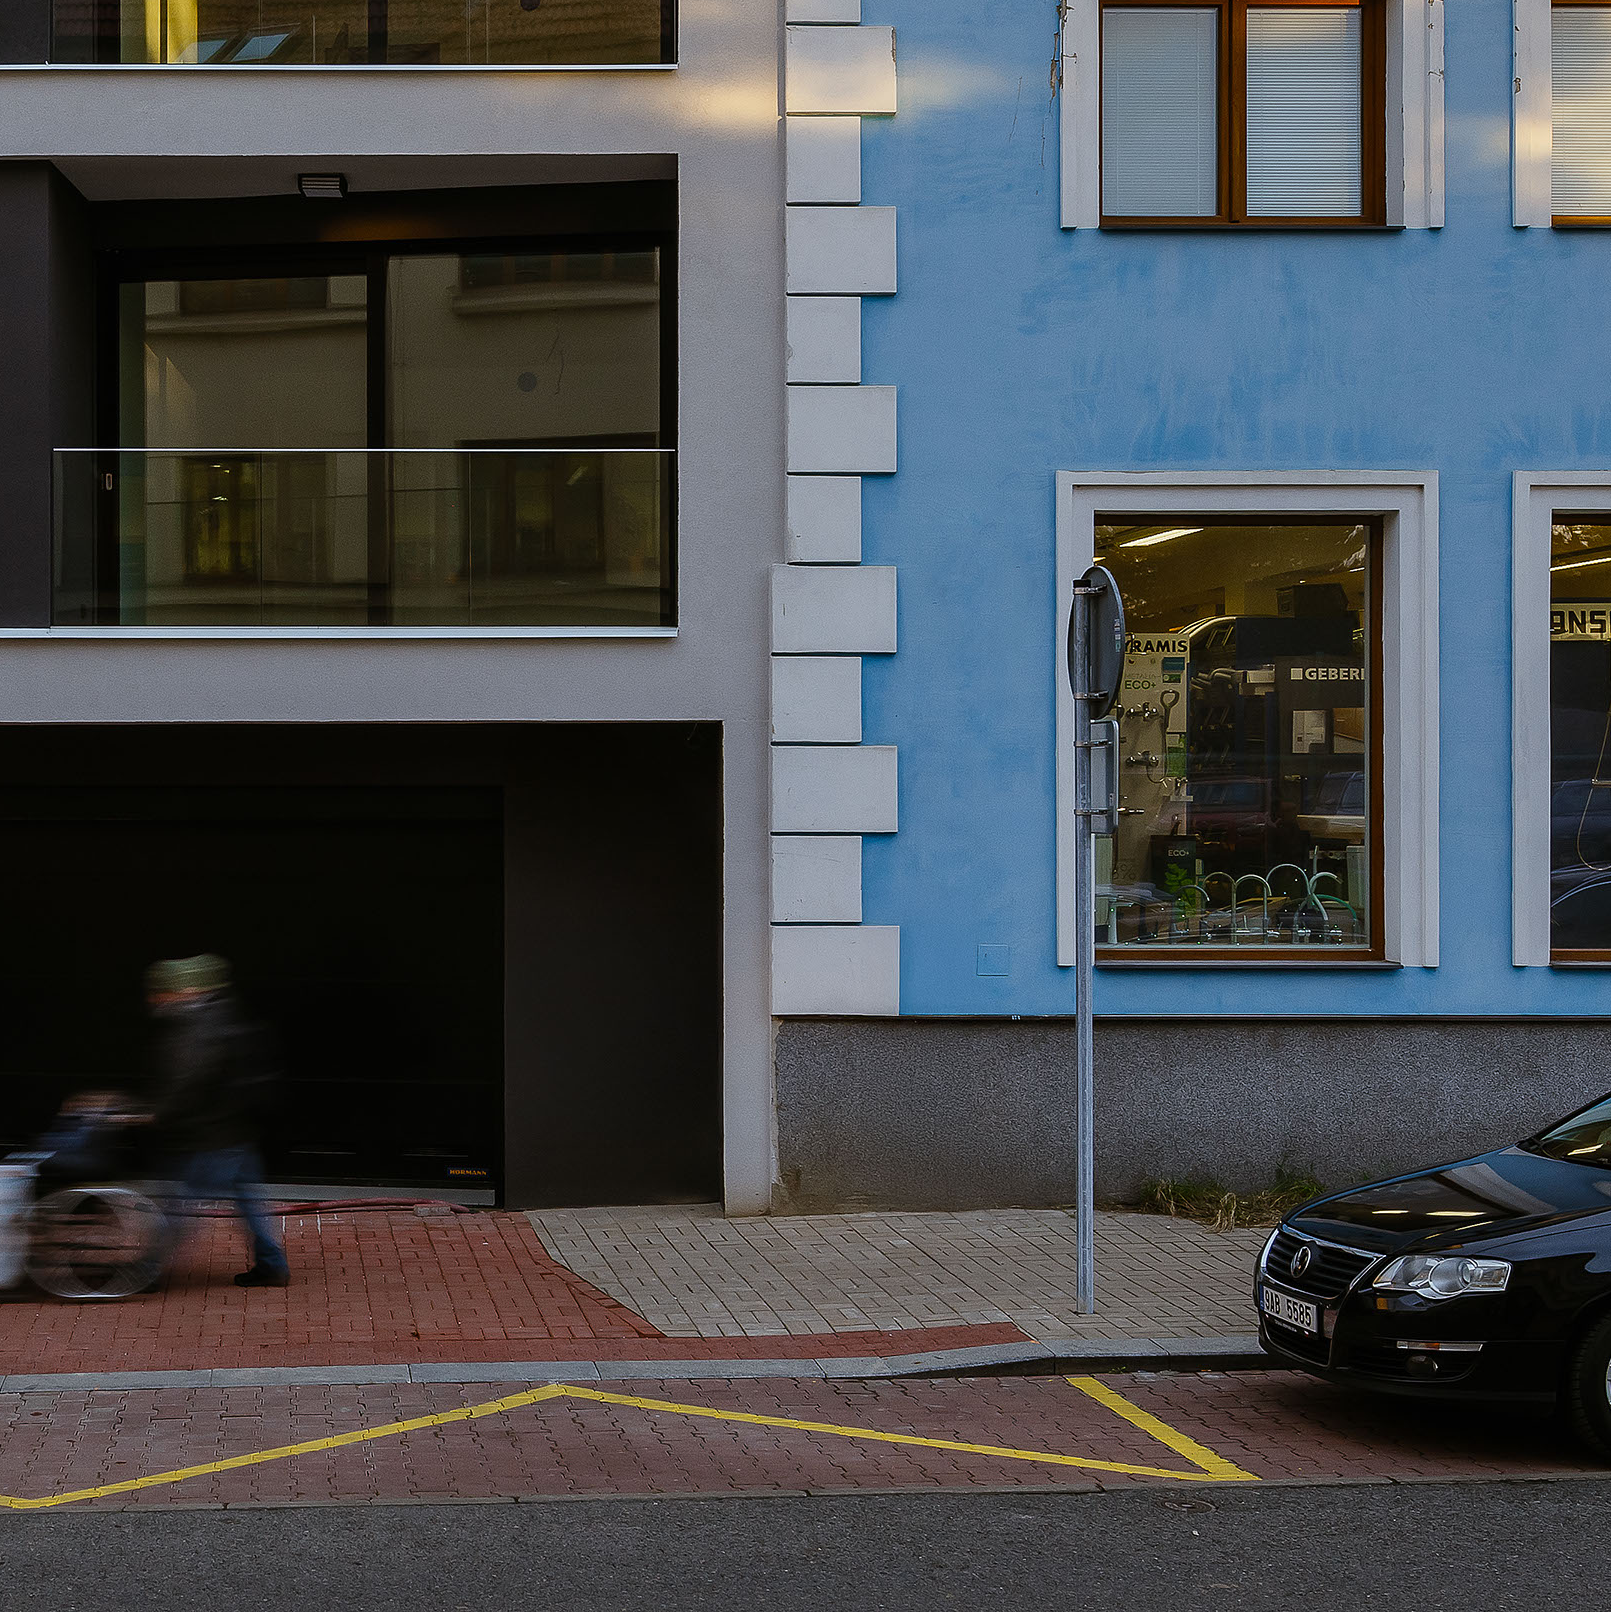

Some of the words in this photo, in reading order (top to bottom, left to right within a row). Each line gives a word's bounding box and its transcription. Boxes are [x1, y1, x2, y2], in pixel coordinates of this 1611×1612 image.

[1124, 679, 1156, 690] ECO+
[1167, 849, 1190, 857] ECO+
[1264, 1289, 1280, 1315] 9AB
[1286, 1298, 1312, 1327] 5585
